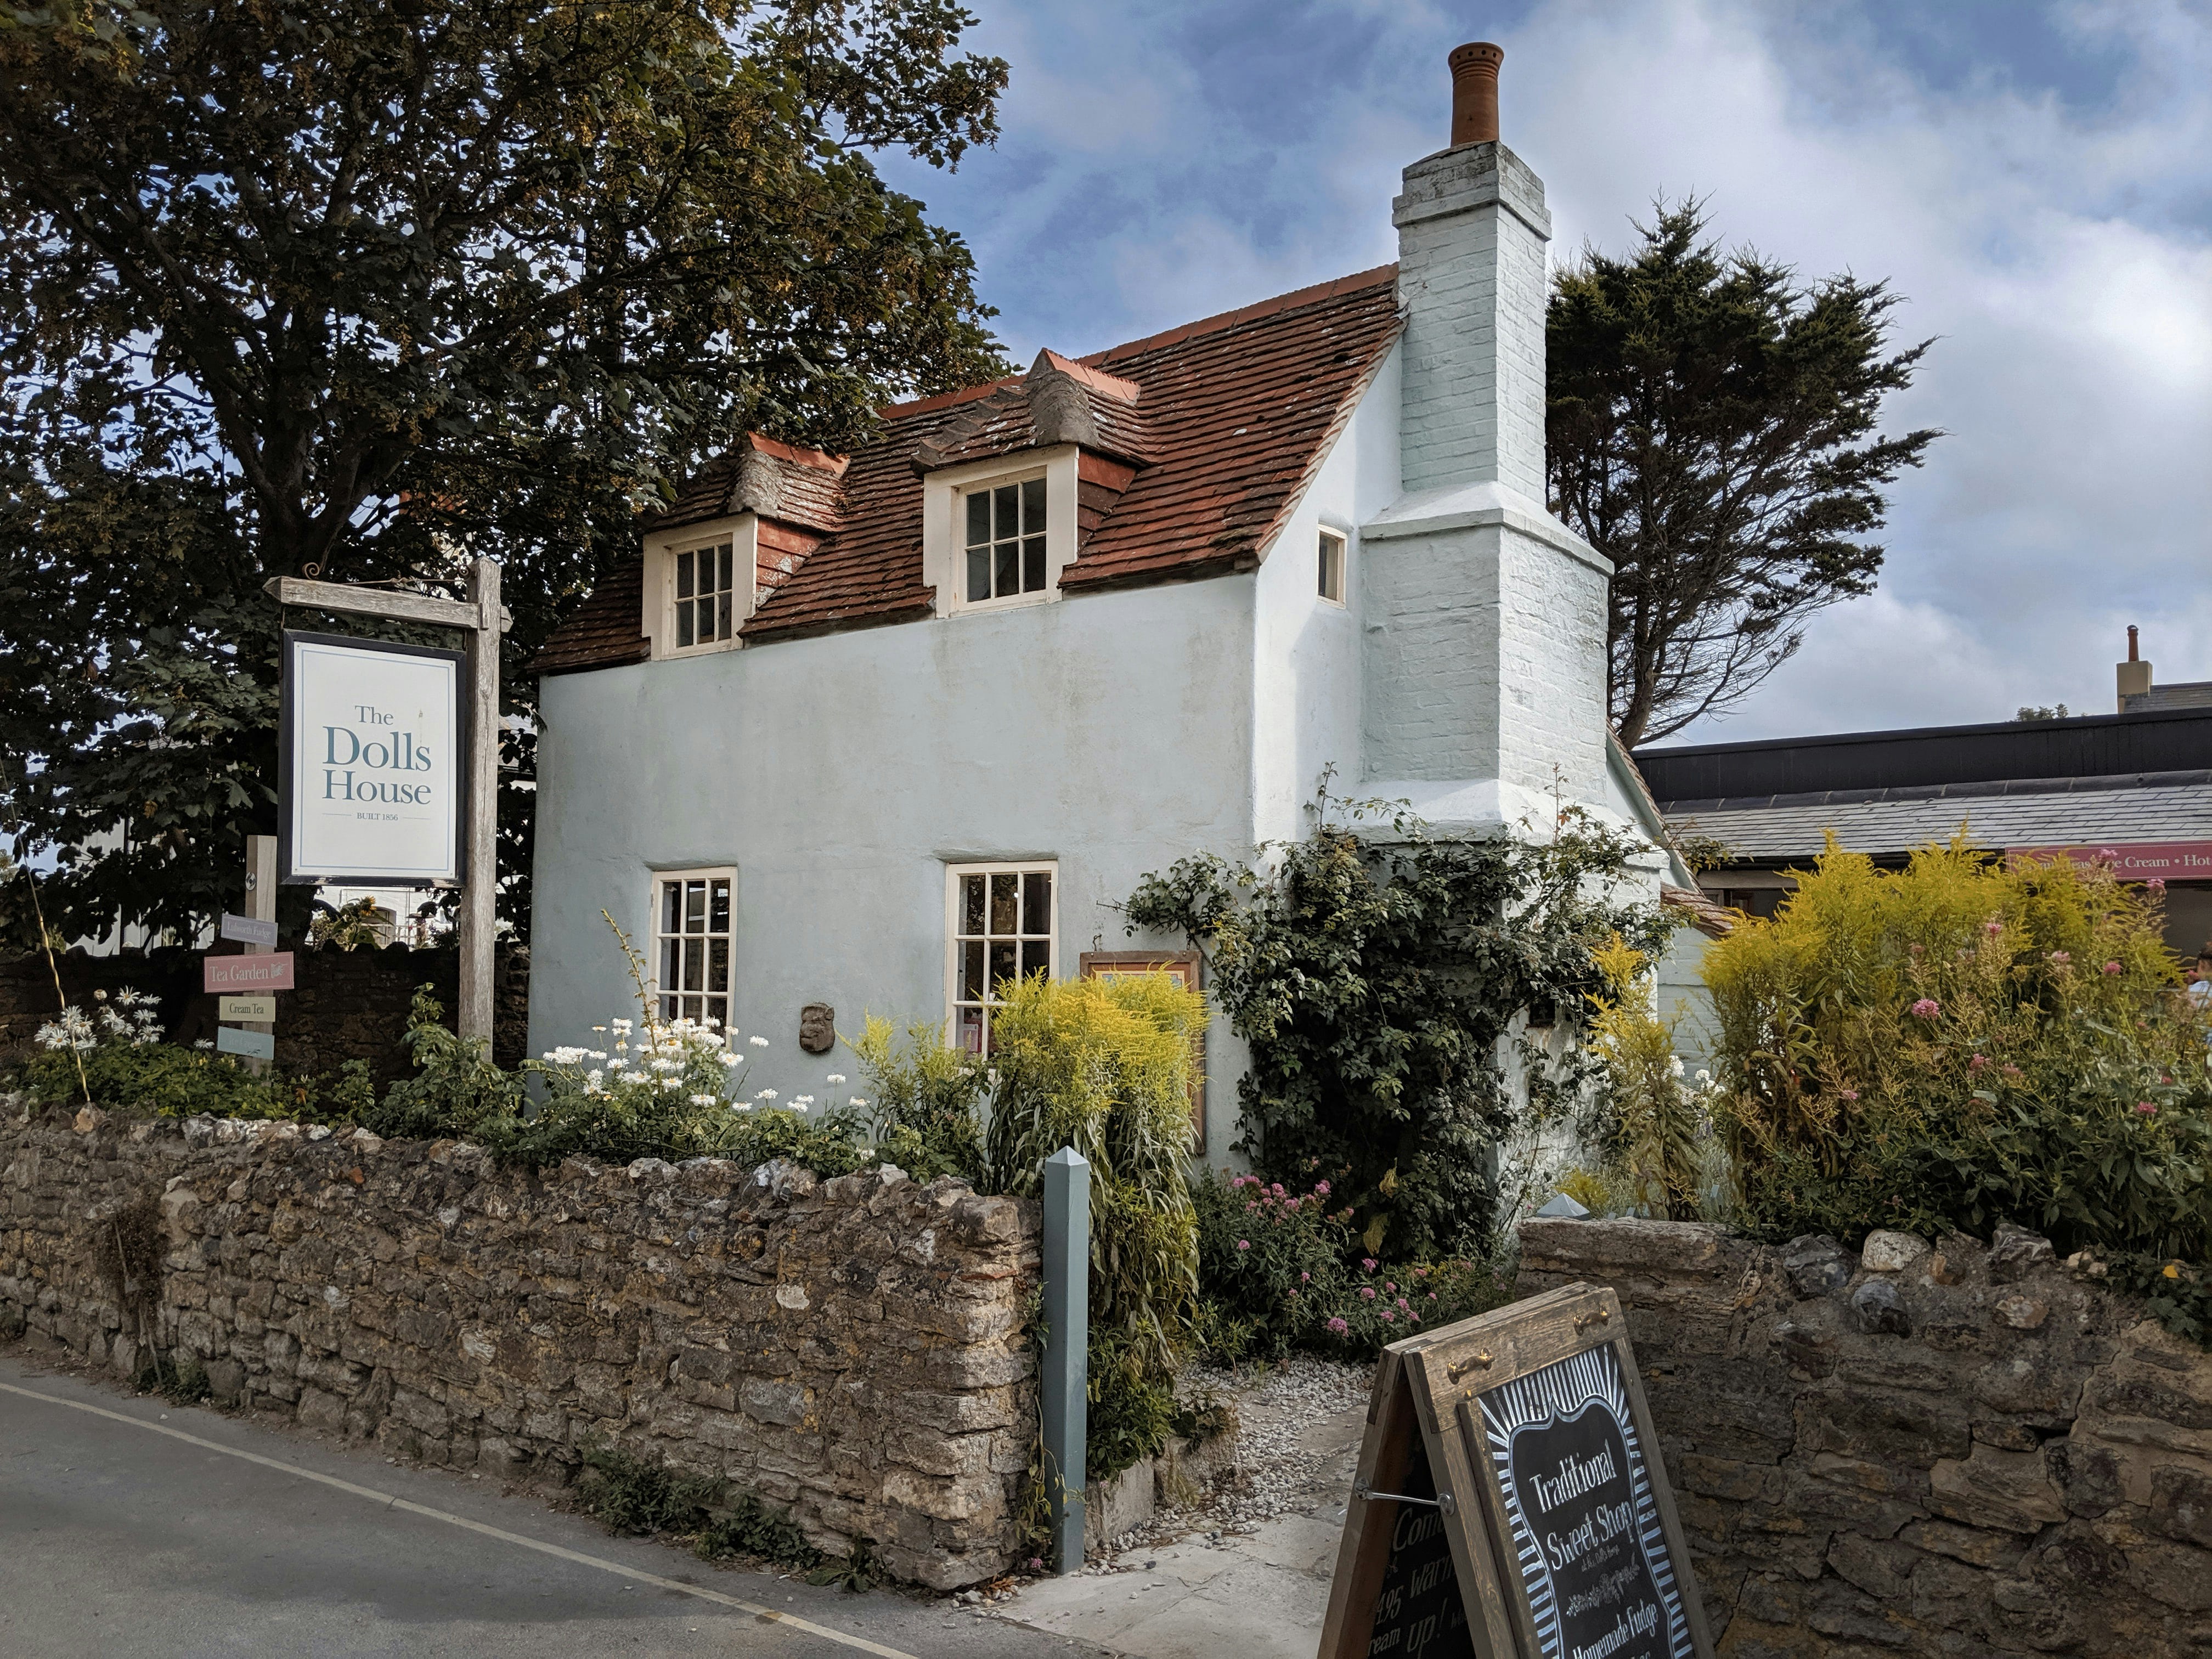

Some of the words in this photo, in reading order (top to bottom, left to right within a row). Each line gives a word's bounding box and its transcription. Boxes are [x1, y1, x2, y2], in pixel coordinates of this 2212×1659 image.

[355, 706, 394, 725] The
[323, 726, 431, 771] Dolls
[322, 769, 431, 805] House
[357, 812, 380, 820] BUILT
[2124, 856, 2170, 868] Cream
[2183, 854, 2211, 867] Hot
[210, 966, 228, 981] Tea
[230, 963, 269, 981] Garden
[229, 1002, 251, 1014] Cream
[252, 1003, 264, 1014] Tea
[1530, 1438, 1617, 1514] Traditional
[1547, 1513, 1599, 1572] Sweet
[1596, 1501, 1634, 1544] Shop
[1626, 1598, 1658, 1638] Fudge
[1368, 1627, 1401, 1657] ream
